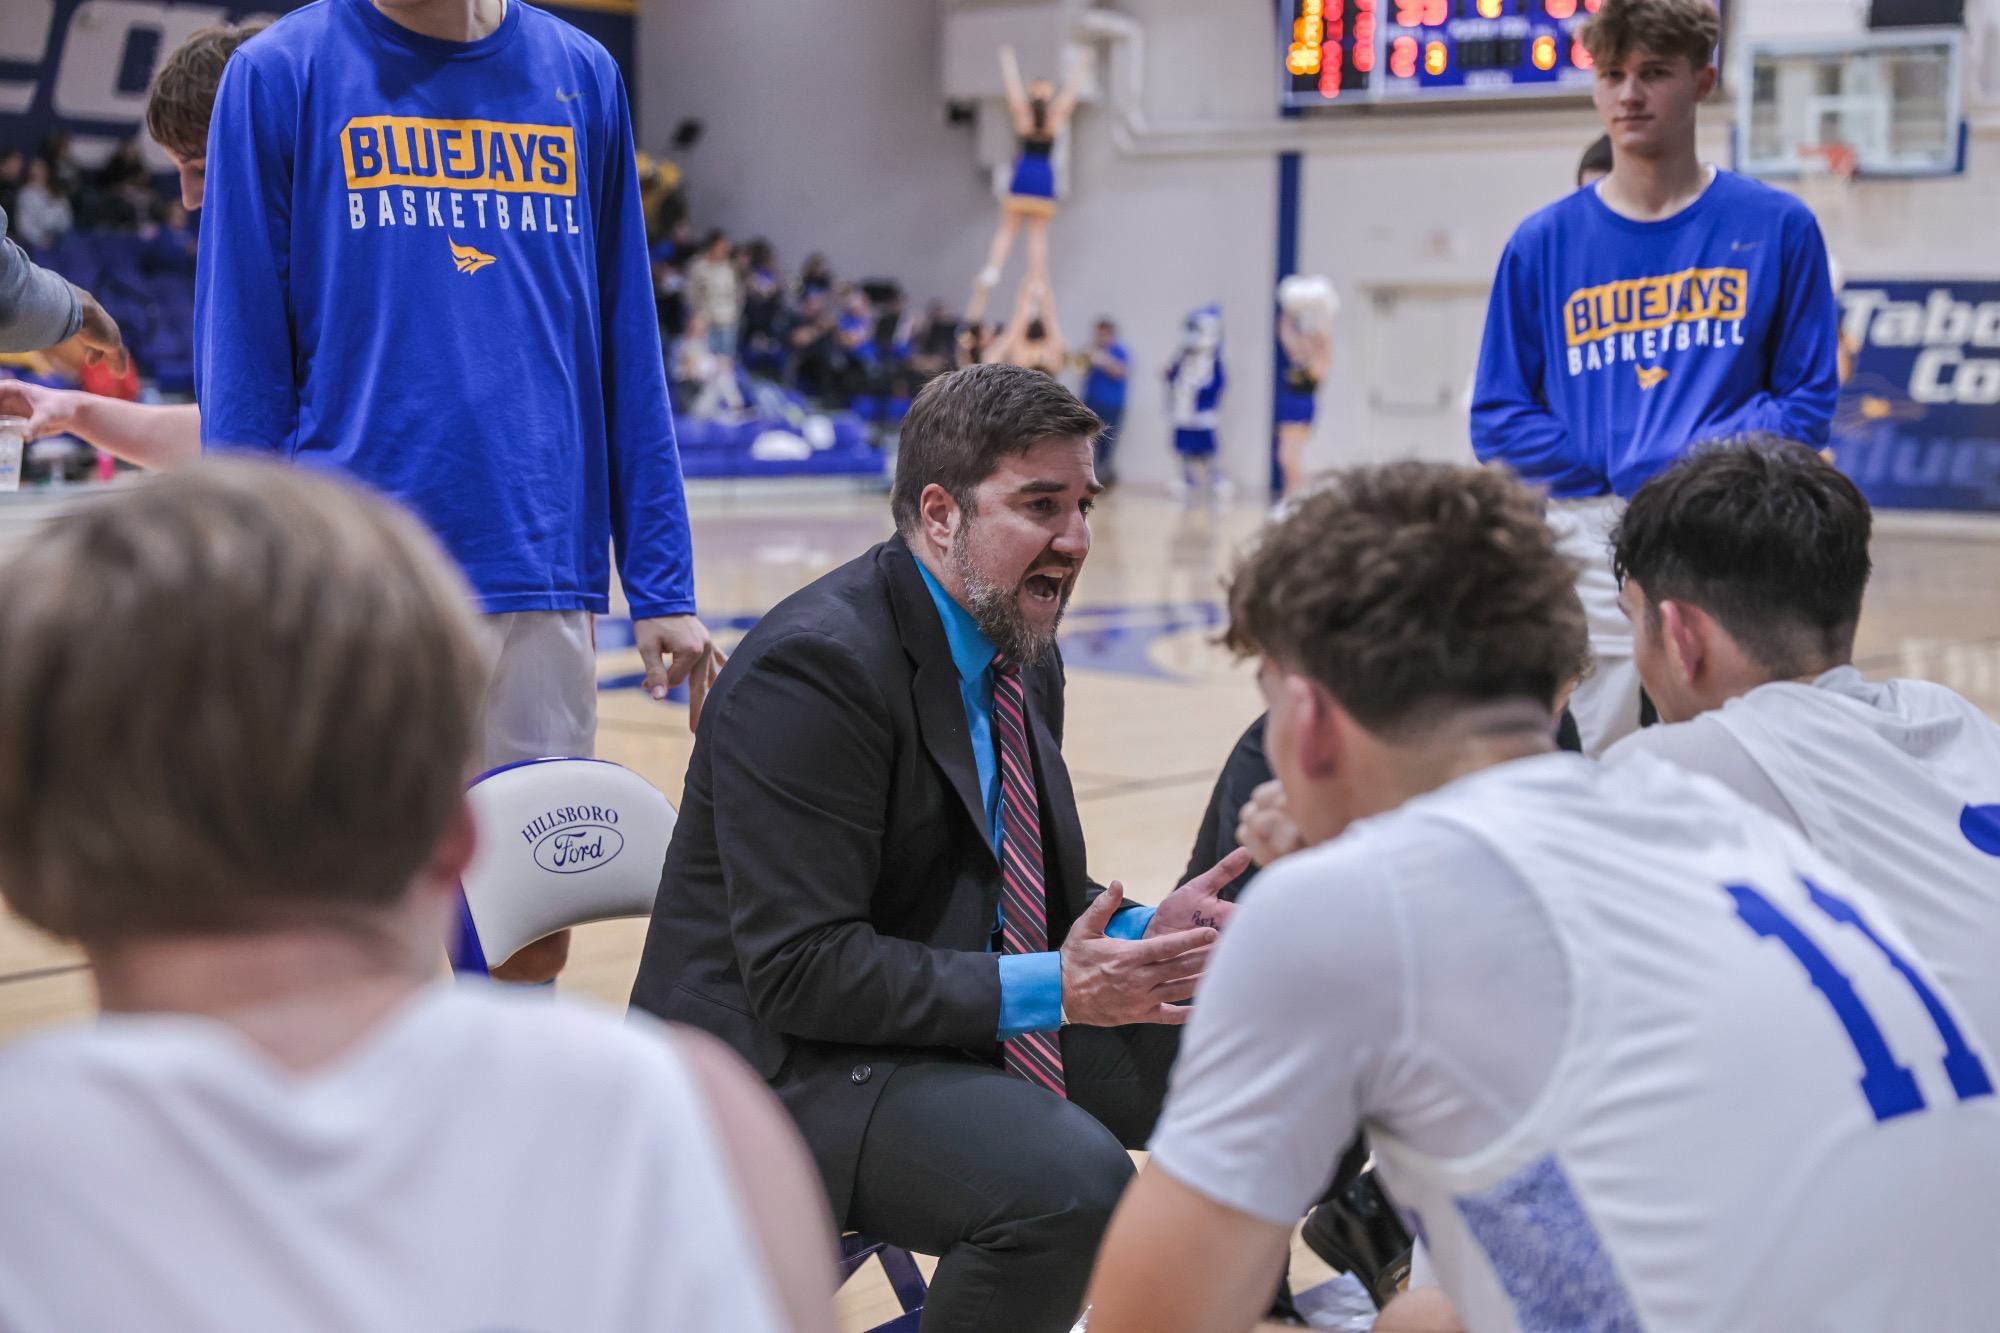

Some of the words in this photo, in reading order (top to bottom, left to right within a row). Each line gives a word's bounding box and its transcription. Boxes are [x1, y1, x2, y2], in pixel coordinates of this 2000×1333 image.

[348, 125, 568, 185] BLUEJAYS
[347, 189, 580, 235] BASKETBALL
[1571, 276, 1739, 336] BLUEJAYS
[1566, 318, 1745, 377] BASKETBALL
[521, 805, 619, 845] HILLSBORO
[553, 831, 605, 867] Ford
[1723, 872, 1996, 1122] 11
